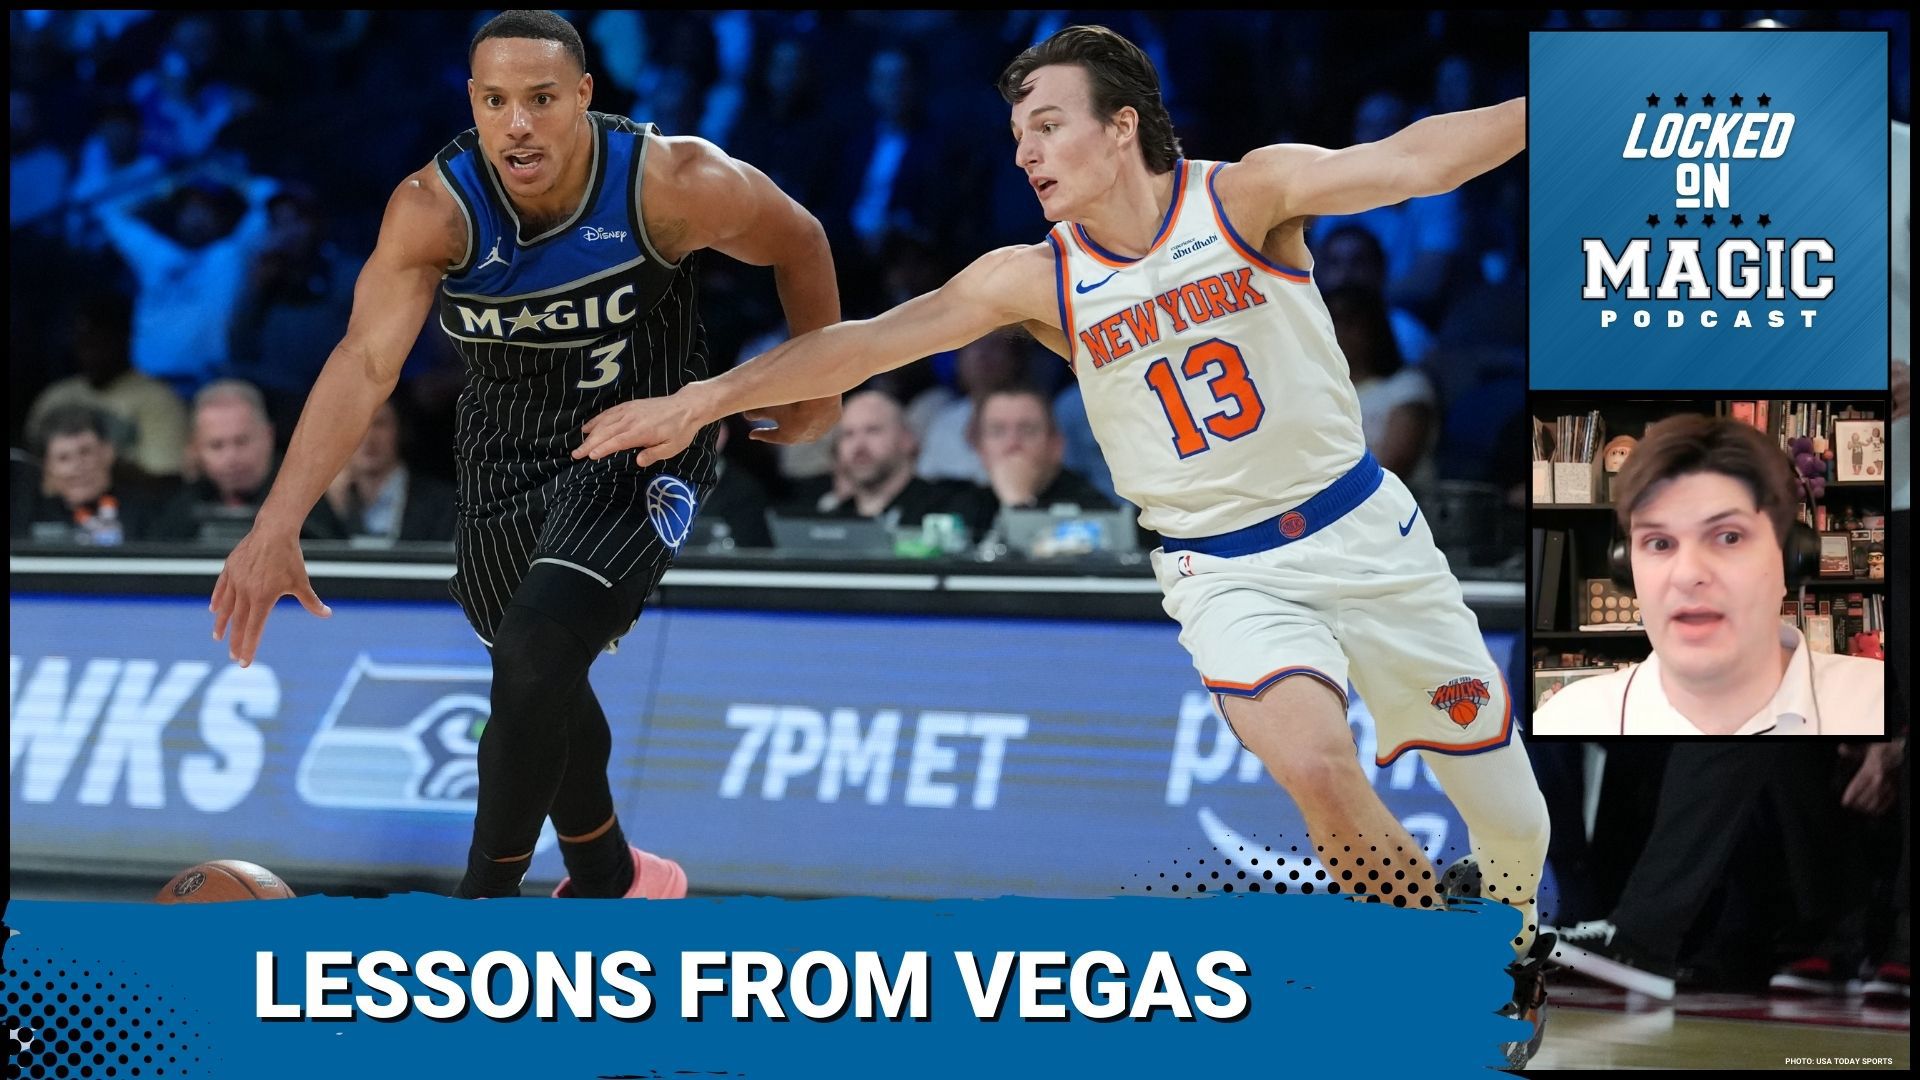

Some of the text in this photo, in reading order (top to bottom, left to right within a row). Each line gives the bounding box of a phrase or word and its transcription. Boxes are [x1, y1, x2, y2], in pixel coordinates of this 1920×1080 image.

[1172, 232, 1218, 260] abu dhabi
[1079, 267, 1268, 369] NEW YORK
[576, 339, 628, 389] 3
[1144, 337, 1266, 460] 13
[1431, 678, 1490, 710] KNICKS
[10, 655, 281, 812] WKS
